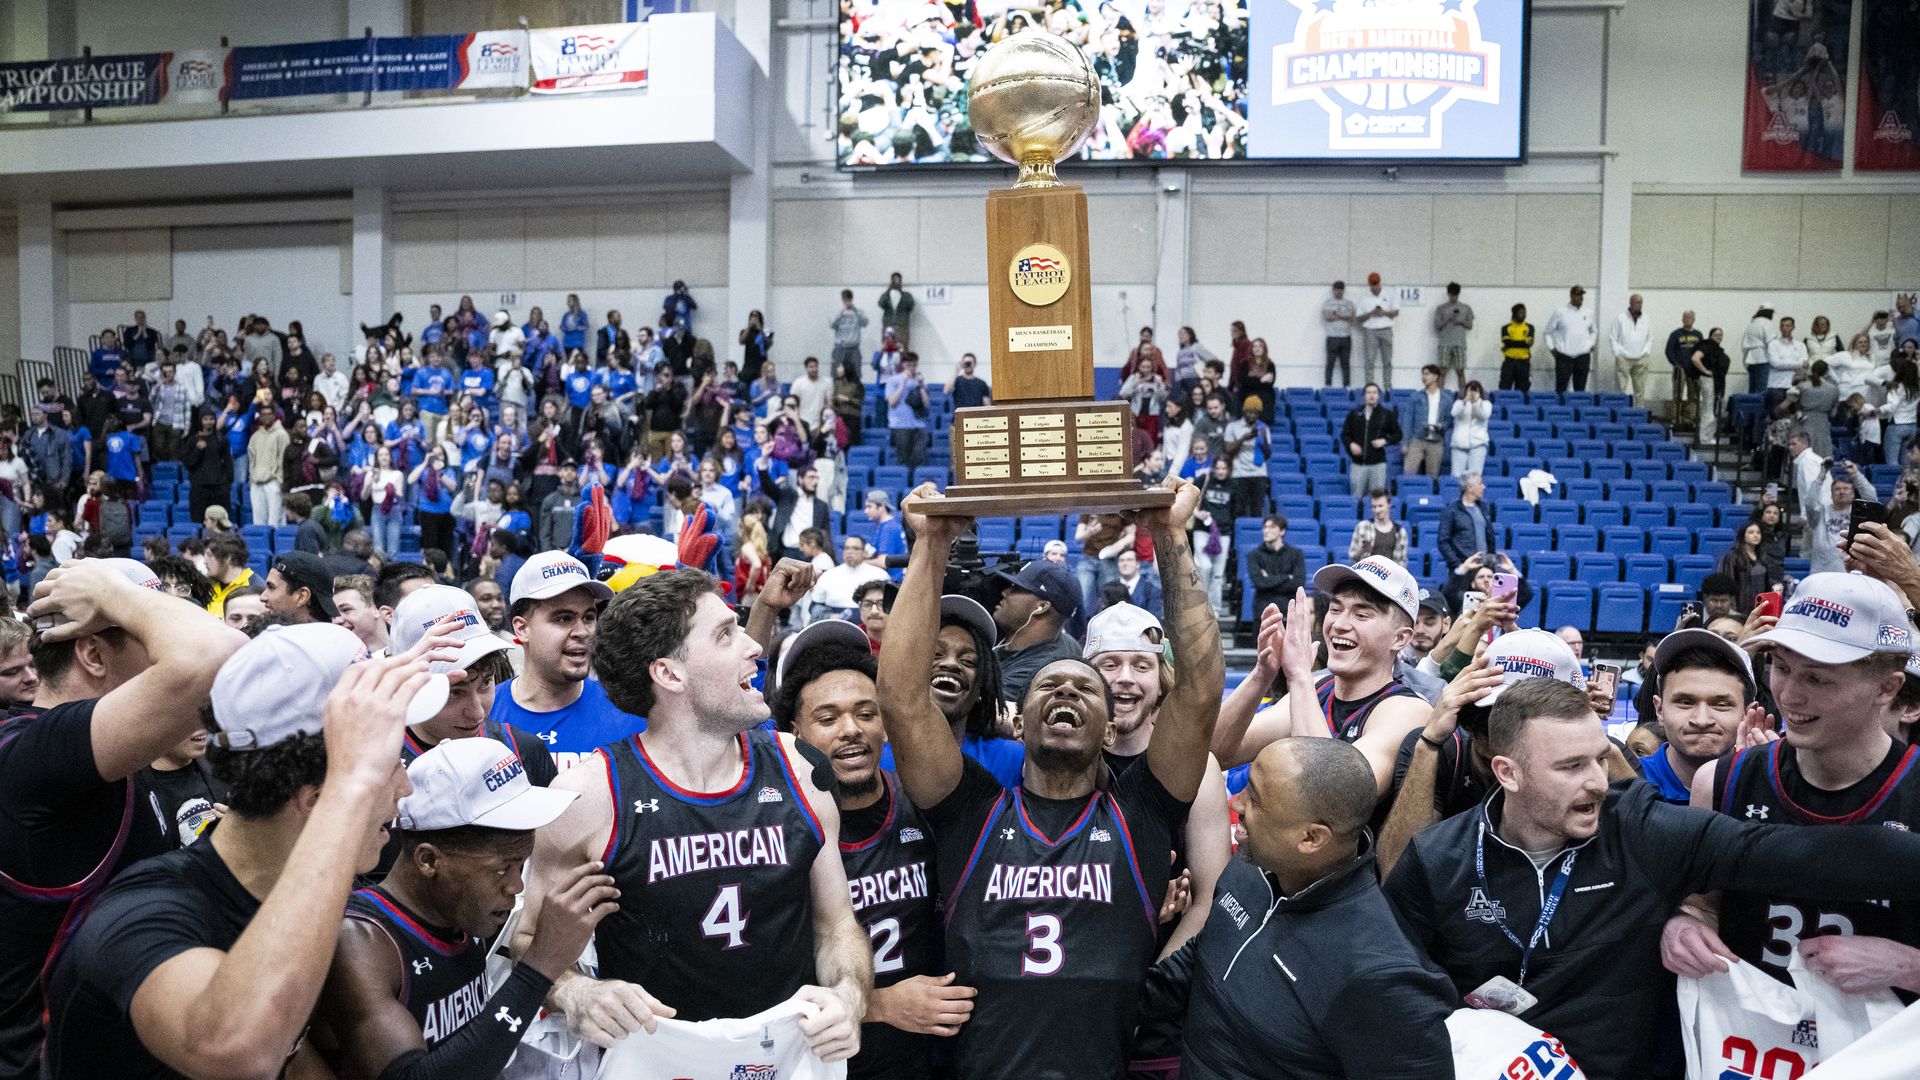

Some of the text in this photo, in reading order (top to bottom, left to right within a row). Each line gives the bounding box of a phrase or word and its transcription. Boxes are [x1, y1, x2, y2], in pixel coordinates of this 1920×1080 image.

[1368, 28, 1456, 49] BASKETBALL
[62, 62, 146, 83] LEAGUE
[1292, 51, 1480, 84] CHAMPIONSHIP
[1015, 270, 1066, 279] PATRIOT
[1015, 276, 1066, 286] LEAGUE
[1400, 288, 1420, 300] 115
[1507, 656, 1532, 664] PATRIOT
[648, 825, 789, 883] AMERICAN
[848, 862, 928, 911] ERICAN
[984, 864, 1112, 904] AMERICAN
[1592, 882, 1614, 890] ARMOUR
[700, 884, 750, 950] 4
[1218, 892, 1250, 930] AMERICAN
[1539, 894, 1554, 924] PATRIOT
[1543, 895, 1561, 925] LEAGUE
[870, 918, 905, 974] 2
[1022, 912, 1066, 976] 3
[423, 969, 489, 1044] AMERICA
